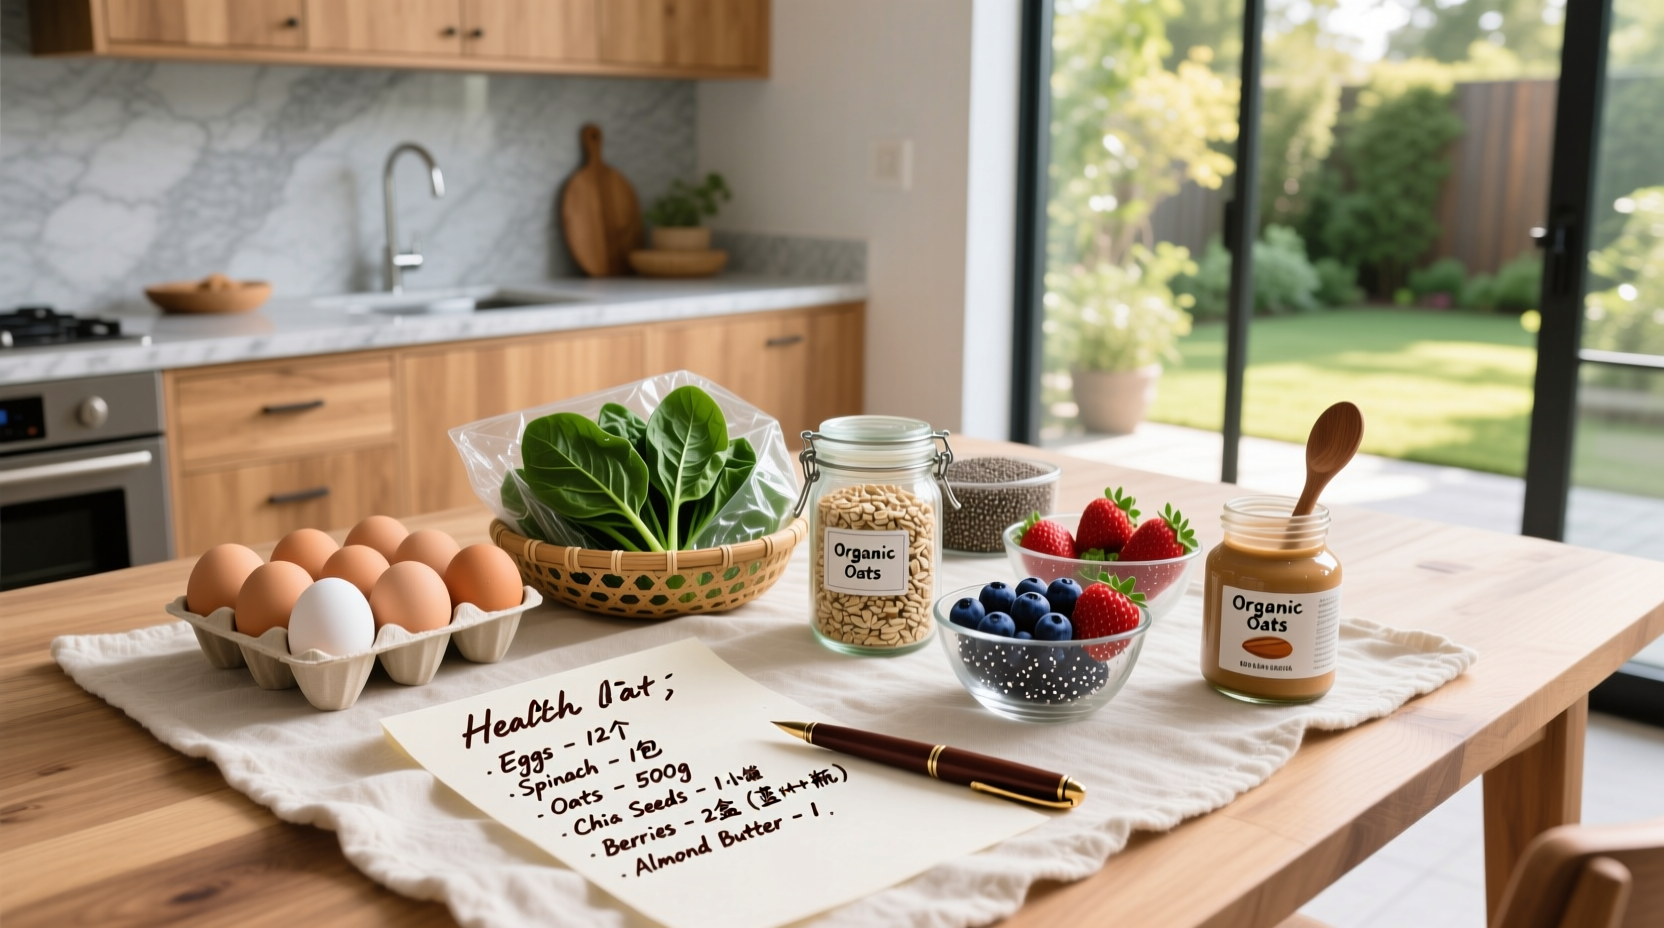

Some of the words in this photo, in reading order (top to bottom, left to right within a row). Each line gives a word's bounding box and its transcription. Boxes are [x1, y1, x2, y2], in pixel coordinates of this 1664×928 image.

[834, 542, 895, 563] Organic
[845, 564, 881, 580] Oats
[1233, 595, 1303, 618] Organic
[1247, 616, 1287, 632] Oats
[499, 748, 553, 777] Eggs
[518, 759, 599, 801] Spinach
[551, 790, 603, 814] Oats
[636, 763, 692, 788] 500g
[574, 814, 623, 835] Chia
[629, 789, 688, 817] Seeds
[602, 824, 676, 856] Berries
[636, 835, 712, 877] Almond
[718, 818, 782, 848] Butter
